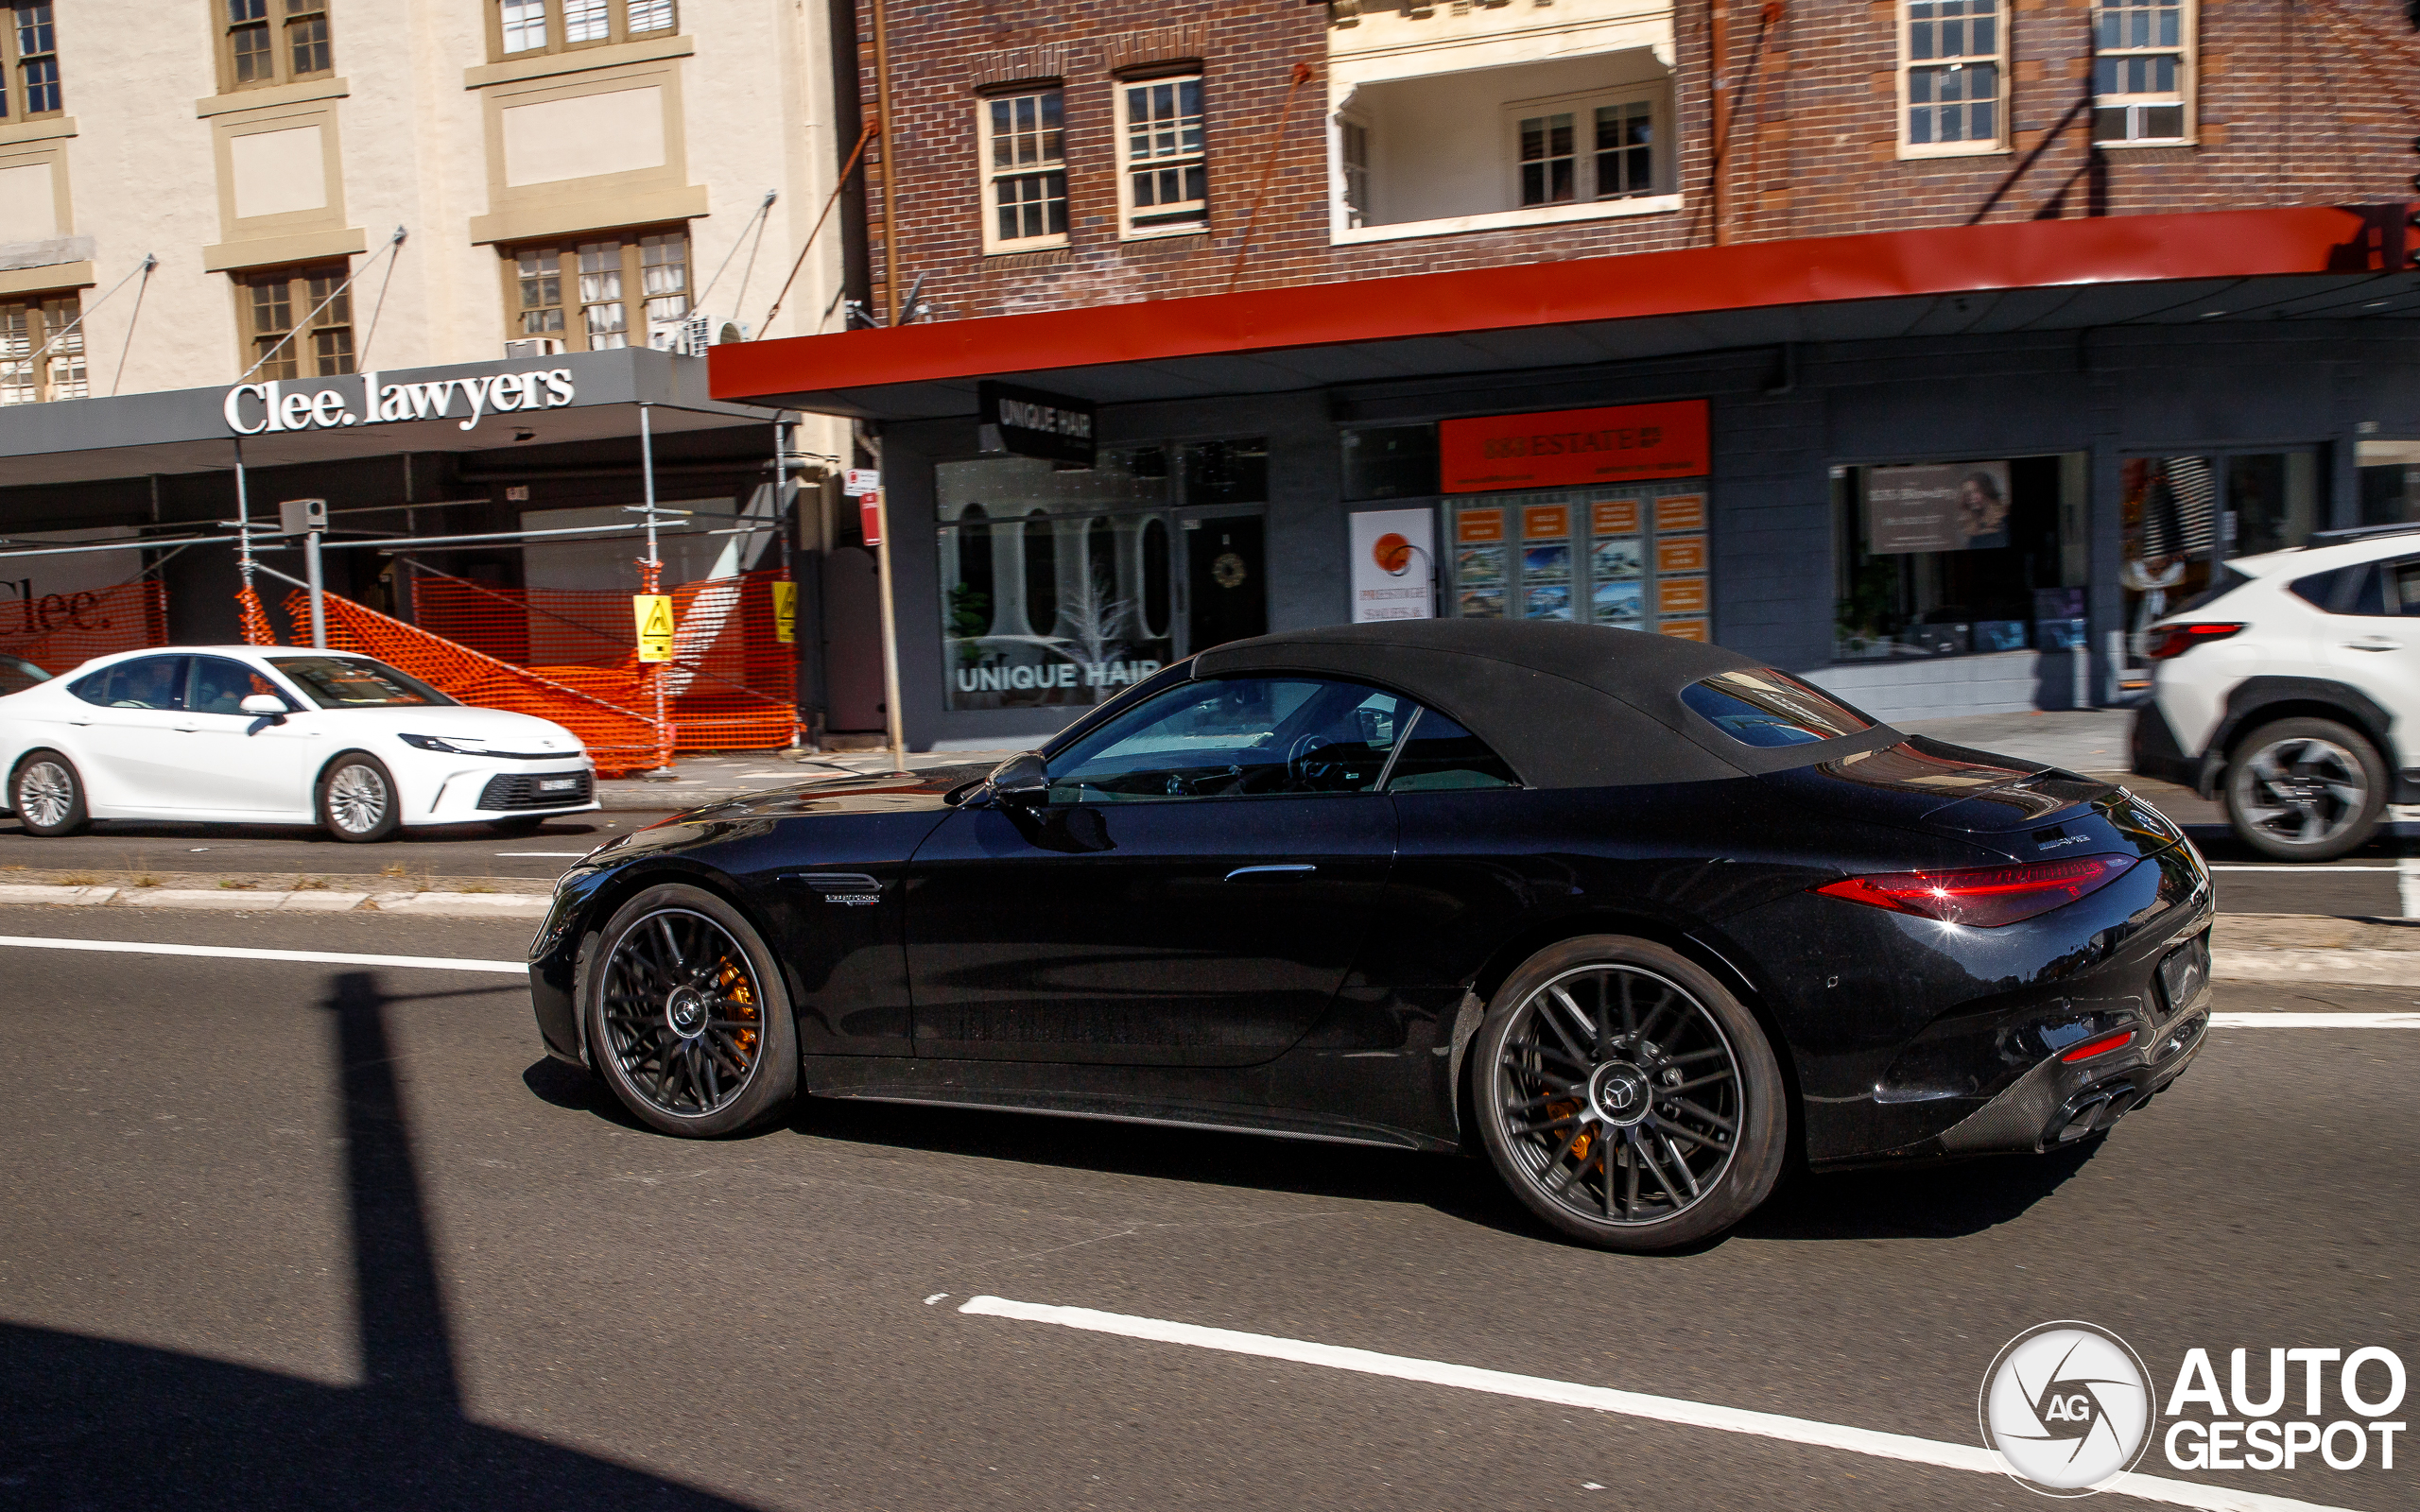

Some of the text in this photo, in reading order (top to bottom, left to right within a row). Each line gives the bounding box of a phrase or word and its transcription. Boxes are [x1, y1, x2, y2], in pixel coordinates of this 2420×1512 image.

[224, 369, 575, 435] Clee. lawyers
[999, 399, 1092, 438] UNIQUE HAIR
[957, 663, 1078, 692] UNIQUE
